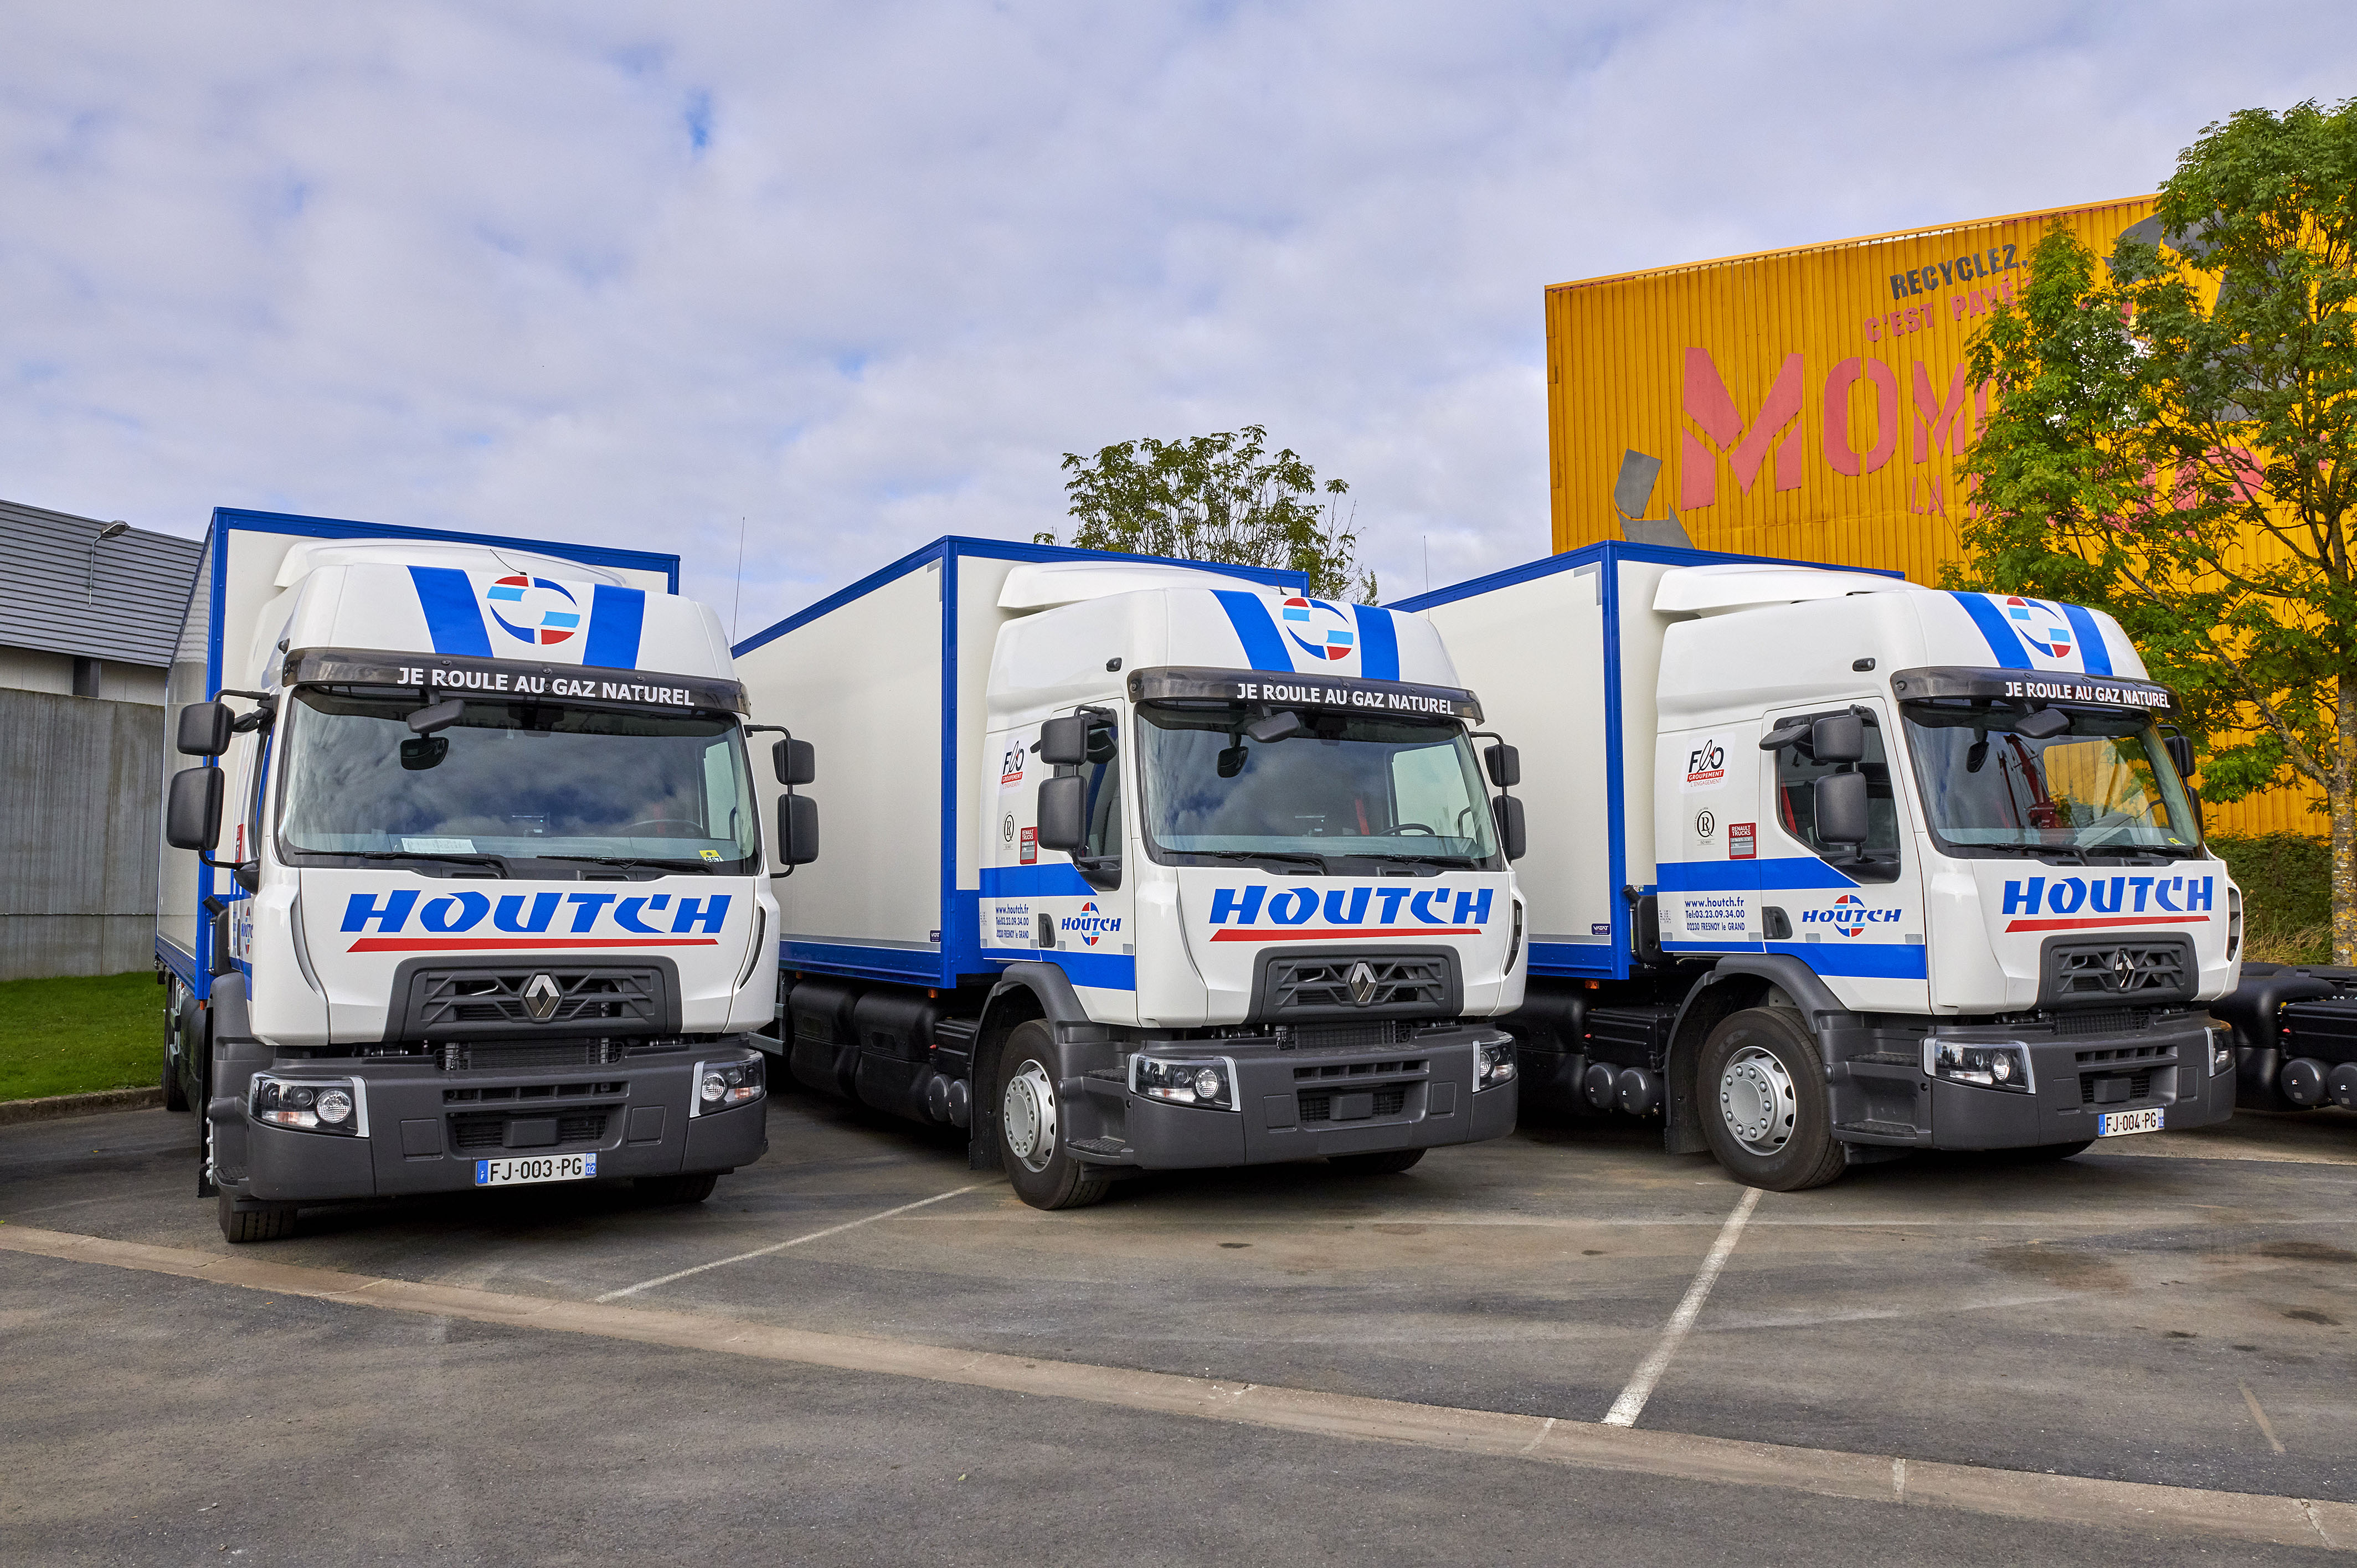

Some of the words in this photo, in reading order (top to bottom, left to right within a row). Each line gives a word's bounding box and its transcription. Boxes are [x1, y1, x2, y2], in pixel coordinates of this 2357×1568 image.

[1890, 244, 2028, 300] RECYCLEZ,
[1864, 302, 1934, 342] C'EST
[397, 667, 424, 685] JE
[431, 669, 508, 691] ROULE
[514, 677, 545, 694] AU
[553, 678, 595, 697] GAZ
[602, 683, 695, 706] NATUREL
[2005, 682, 2022, 697] JE
[2026, 682, 2072, 699] ROULE
[2075, 685, 2092, 700] AU
[2095, 687, 2121, 703] GAZ
[2123, 689, 2170, 708] NATUREL
[1237, 684, 1258, 699] JE
[1263, 684, 1320, 703] ROULE
[1325, 689, 1347, 705] AU
[1352, 690, 1385, 708] GAZ
[1389, 694, 1455, 715] NATUREL
[1689, 771, 1723, 780] GROUPEMENT
[1209, 886, 1494, 925] HOUTCH
[1685, 896, 1744, 907] www.houtch.fr
[2002, 876, 2213, 915] HOUTCH
[340, 889, 732, 934] HOUTCH
[996, 904, 1029, 914] www.houtch.fr
[1685, 910, 1745, 918] Tel:03.23.09.34.00
[1802, 909, 1902, 922] HOUTCH
[1061, 917, 1121, 931] HOUTCH
[1687, 922, 1700, 931] 02230
[1701, 922, 1720, 931] FRESNOY
[1721, 922, 1726, 931] le
[2106, 1112, 2156, 1133] FJ-004-PG
[490, 1157, 582, 1182] FJ-003-PG
[586, 1165, 595, 1174] 02
